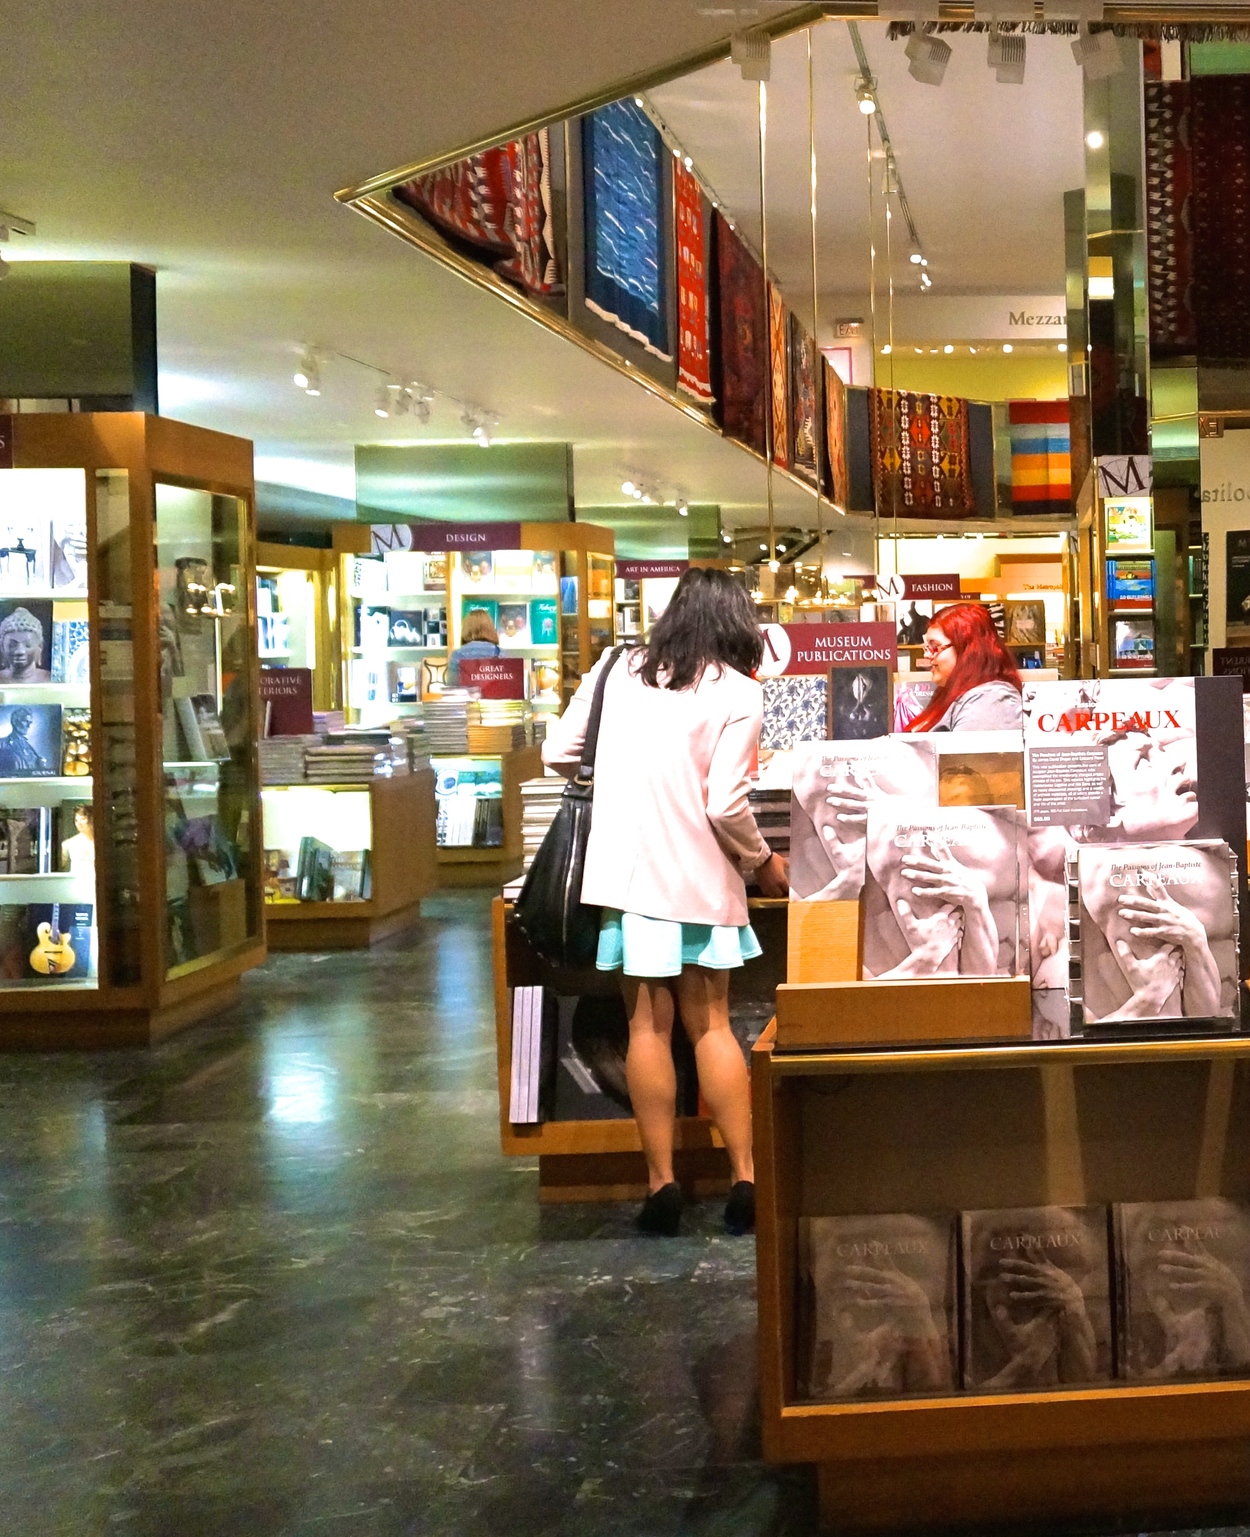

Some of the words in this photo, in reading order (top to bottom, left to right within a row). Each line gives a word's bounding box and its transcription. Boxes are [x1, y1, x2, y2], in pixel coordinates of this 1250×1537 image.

[446, 533, 487, 543] DESIGN
[911, 583, 953, 592] FASHION
[815, 635, 872, 648] MUSEUM
[797, 648, 891, 662] PUBLICATIONS
[479, 665, 504, 673] GREAT
[471, 673, 513, 681] DESIGNERS
[1037, 710, 1182, 733] CARPEAUX
[1122, 863, 1150, 871] Passions
[990, 1233, 1081, 1251] CARPEAUX
